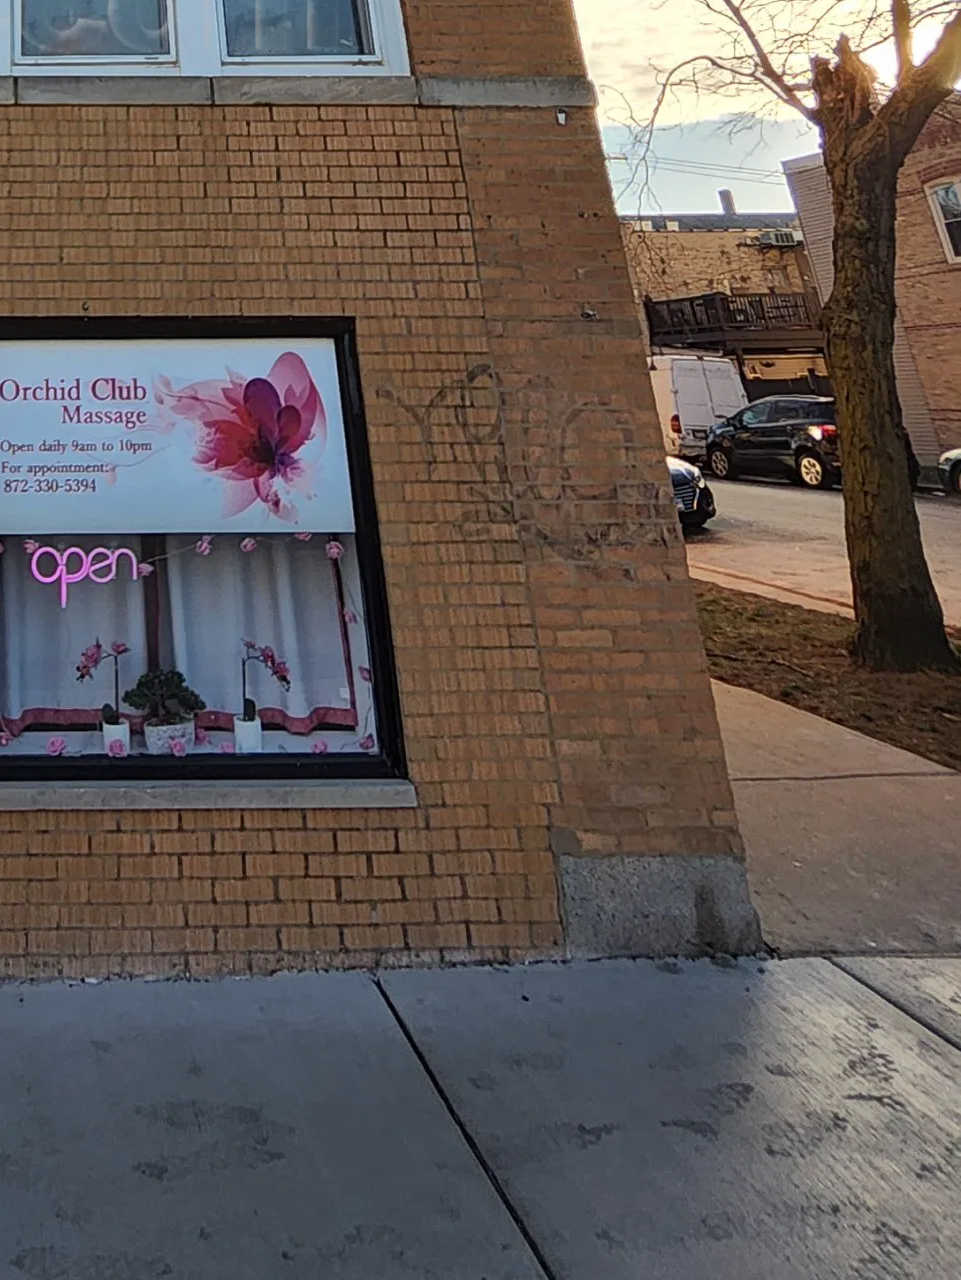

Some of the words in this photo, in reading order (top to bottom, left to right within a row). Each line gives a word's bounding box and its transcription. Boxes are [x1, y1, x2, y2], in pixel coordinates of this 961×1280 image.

[91, 377, 148, 401] Club
[61, 404, 147, 429] Massage
[0, 439, 35, 455] Open
[38, 439, 67, 455] daily
[71, 439, 98, 452] 9am
[101, 440, 114, 452] to
[118, 439, 153, 455] 10pm
[0, 461, 23, 473] For
[3, 478, 97, 493] 872-330-5394
[31, 546, 138, 609] open
